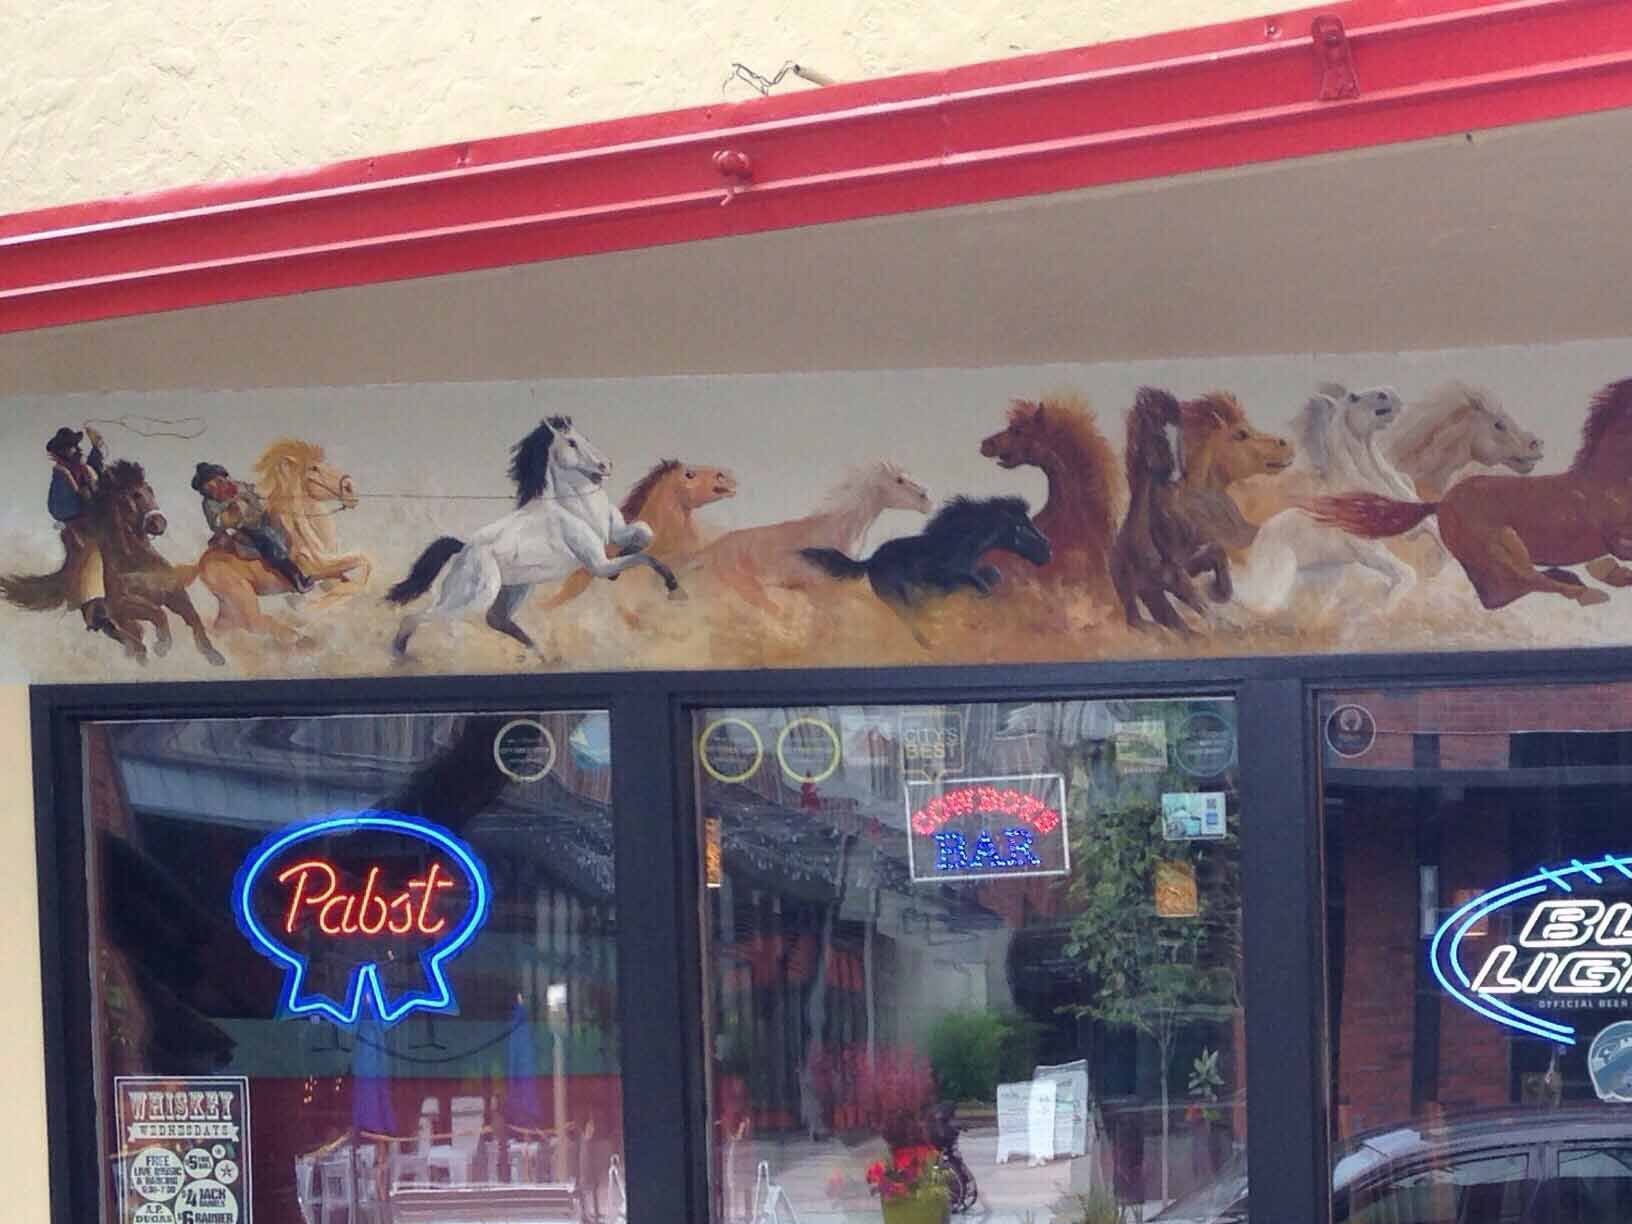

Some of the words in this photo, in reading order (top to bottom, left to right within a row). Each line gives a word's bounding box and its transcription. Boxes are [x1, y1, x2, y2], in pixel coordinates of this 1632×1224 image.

[934, 828, 1041, 871] BAR
[279, 861, 455, 934] Pabst
[1538, 1000, 1593, 1008] OFFICIAL
[1599, 999, 1628, 1008] BEER
[128, 1091, 234, 1120] WHISKEY
[146, 1156, 169, 1166] FREE
[199, 1189, 226, 1199] JACK
